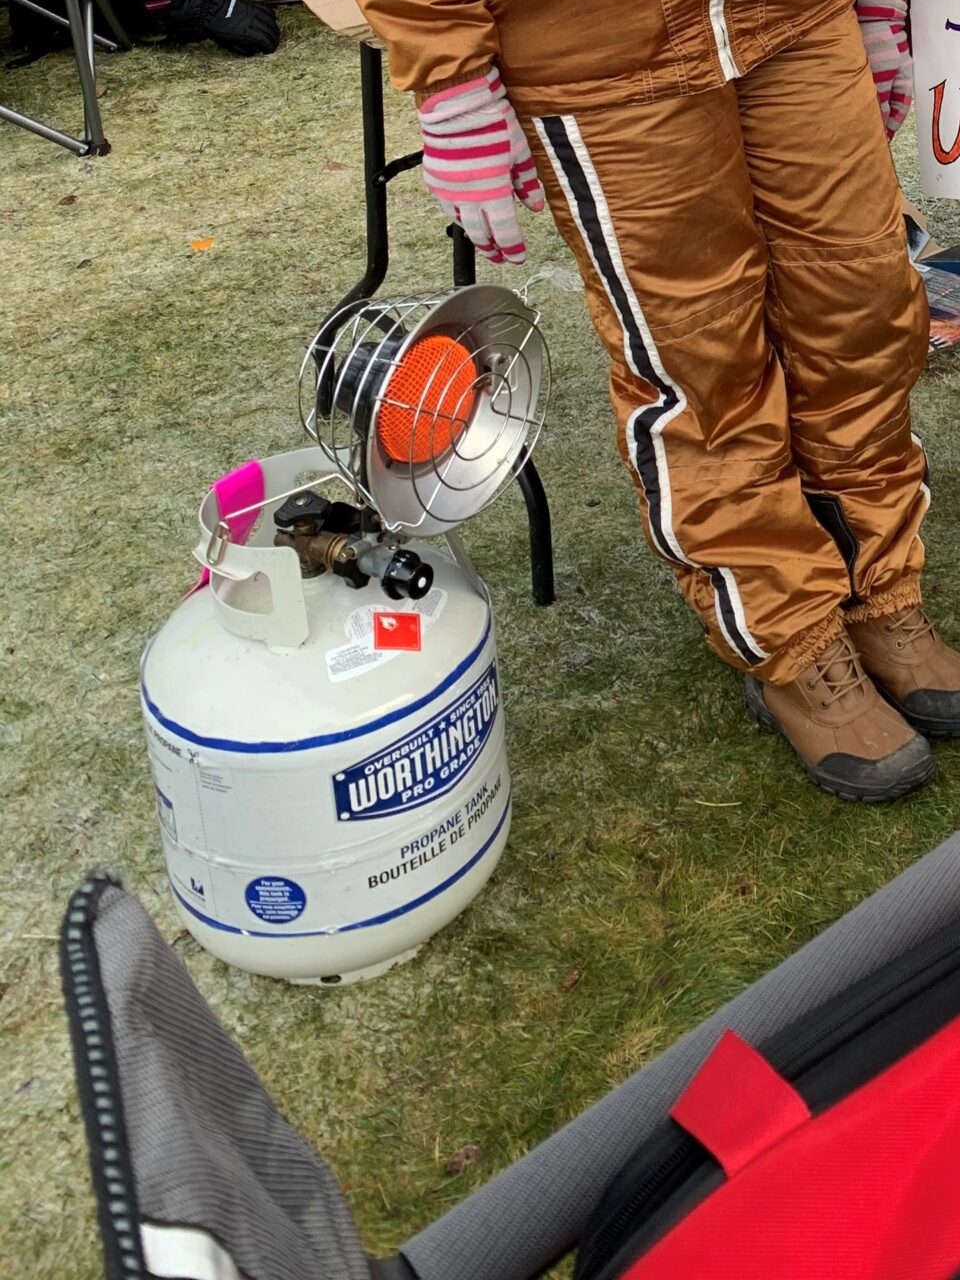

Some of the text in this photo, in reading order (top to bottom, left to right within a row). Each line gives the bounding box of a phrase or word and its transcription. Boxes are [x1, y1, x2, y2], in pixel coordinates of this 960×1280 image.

[349, 679, 497, 812] WORTHINGTON
[364, 728, 434, 775] OVERBUILT
[450, 694, 476, 723] SINCE
[402, 736, 481, 803] PRO GRADE
[368, 838, 447, 889] BOUTEILLE
[450, 824, 465, 846] DE
[401, 782, 488, 859] PROPANE TANK
